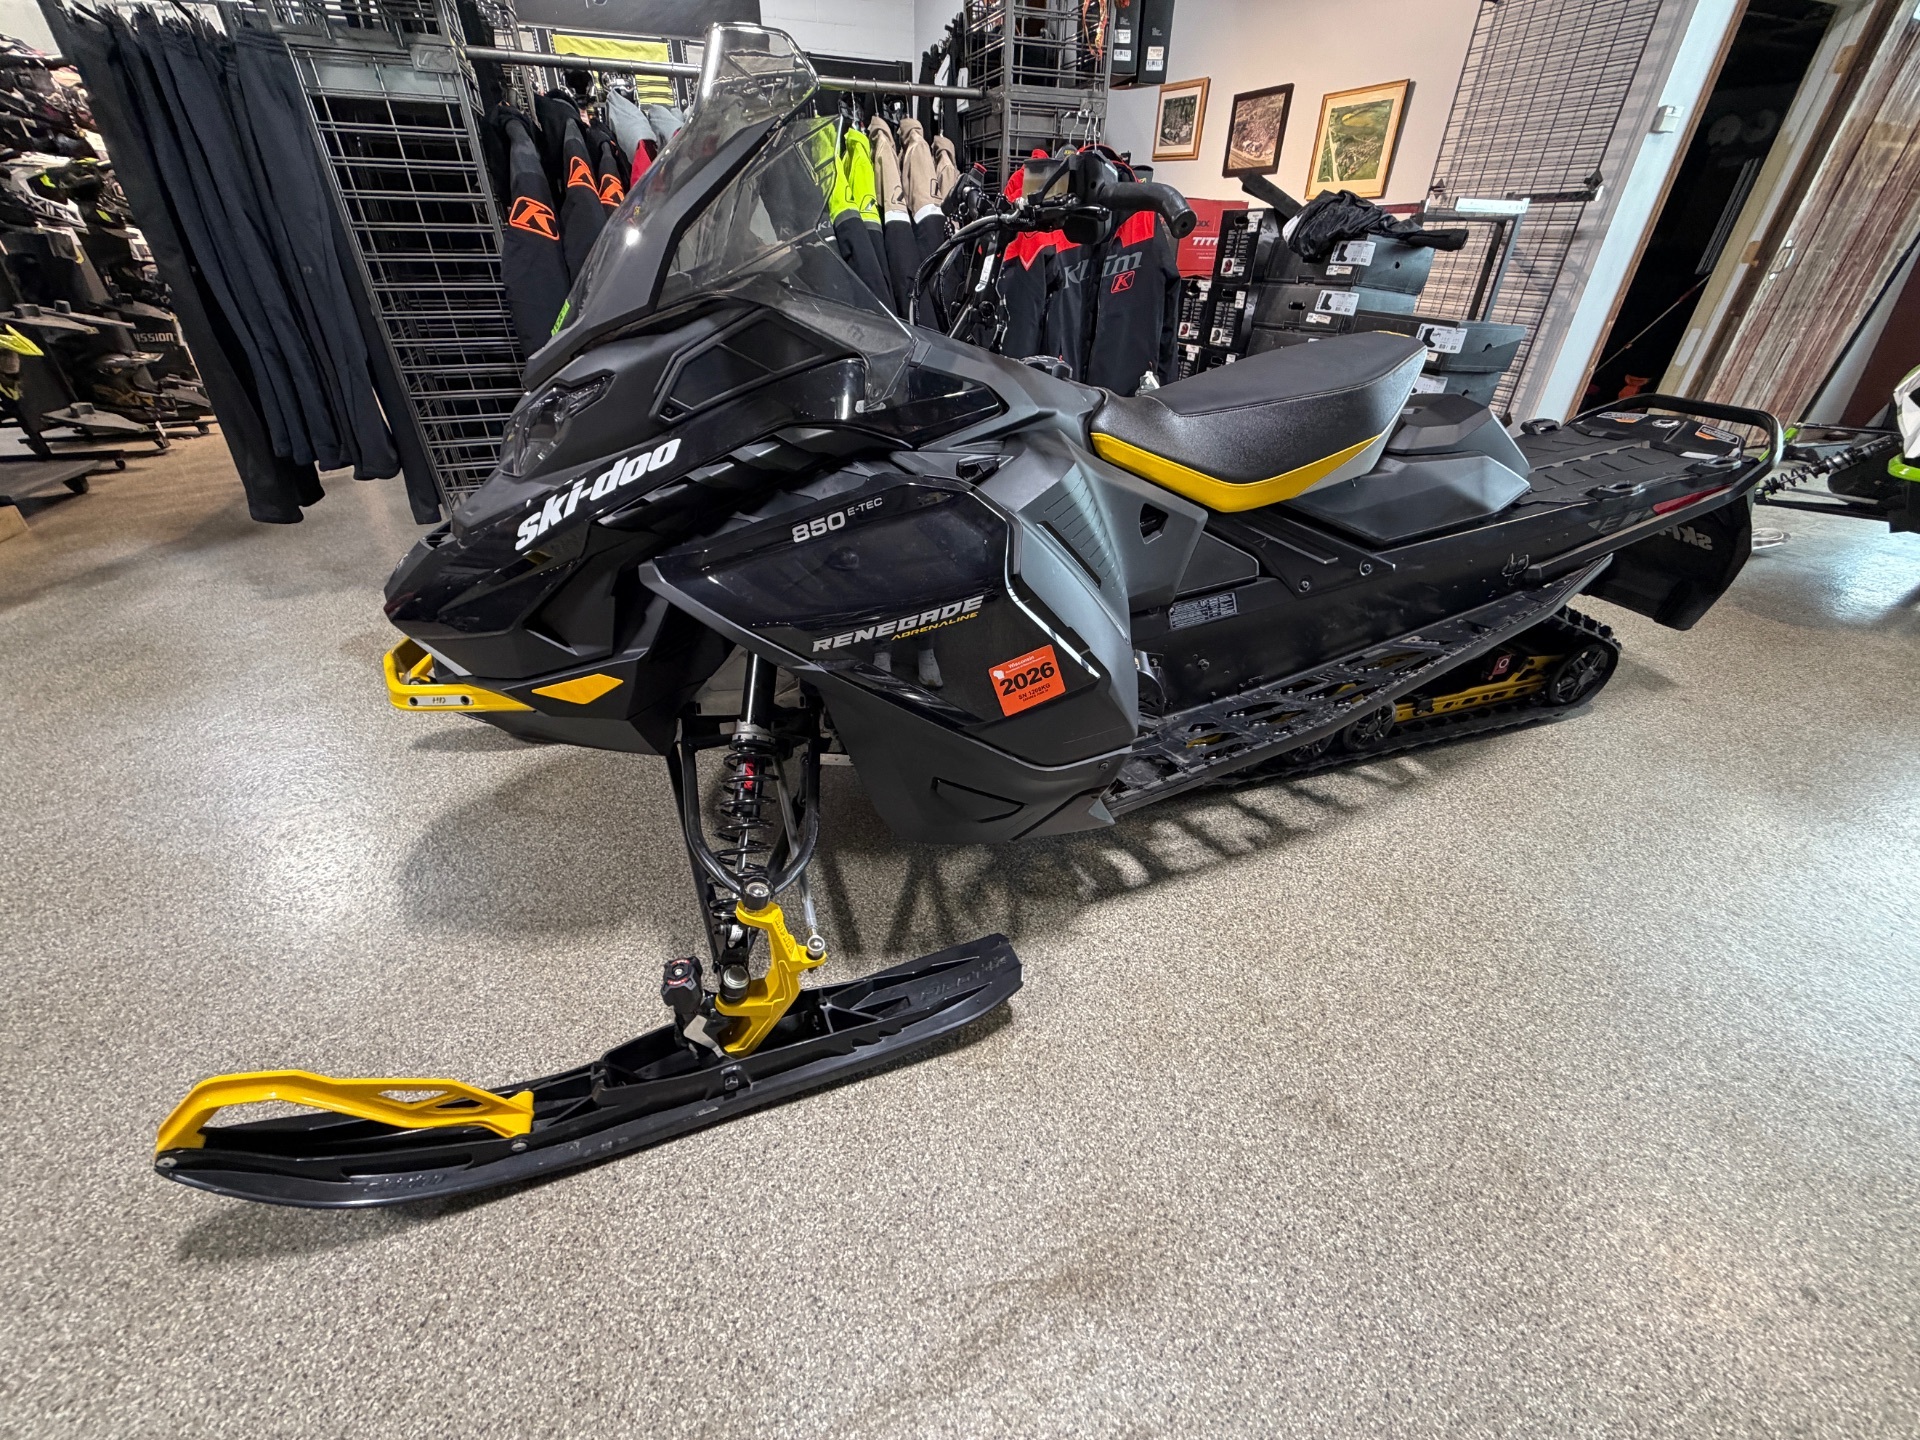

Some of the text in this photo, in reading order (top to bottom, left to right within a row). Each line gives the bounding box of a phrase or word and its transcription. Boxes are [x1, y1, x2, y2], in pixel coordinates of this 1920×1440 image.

[511, 201, 555, 235] K
[792, 497, 883, 543] 850 E-TEC
[812, 595, 985, 652] RENEGADE
[891, 611, 979, 640] ADRENALINE
[1000, 661, 1055, 696] 2026
[1008, 655, 1035, 669] Wisconsin
